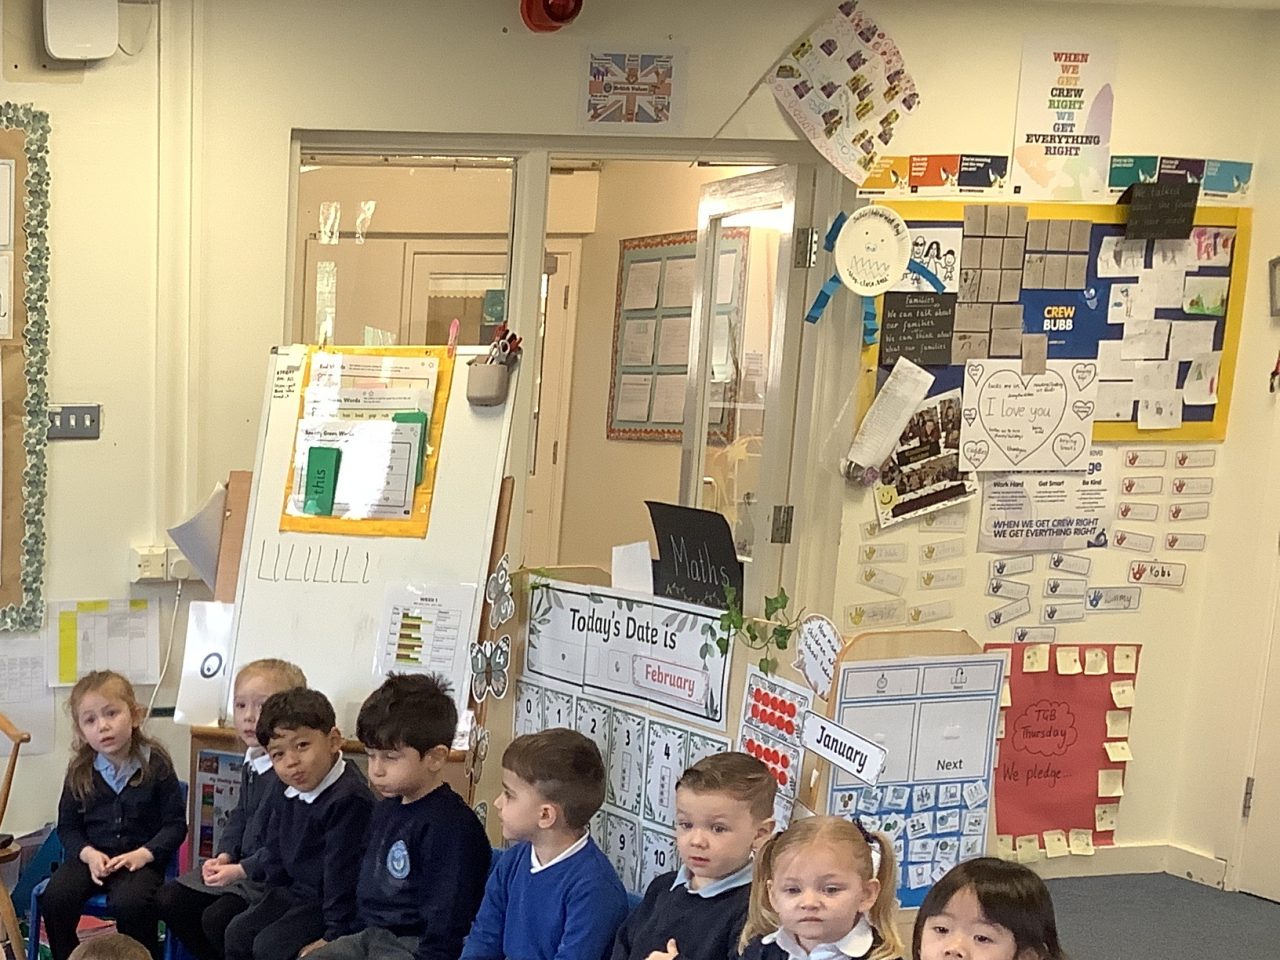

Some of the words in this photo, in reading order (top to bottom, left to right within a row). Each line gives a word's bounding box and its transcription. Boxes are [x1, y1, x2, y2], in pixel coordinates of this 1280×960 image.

[1053, 52, 1089, 63] WHEN
[1061, 64, 1079, 74] WE
[1057, 76, 1080, 86] GET
[1050, 88, 1084, 98] CREW
[1048, 100, 1084, 110] RIGHT
[1056, 111, 1075, 121] WE
[1053, 123, 1075, 133] GET
[1025, 134, 1101, 146] EVERYTHING
[1044, 146, 1080, 156] RIGHT
[1044, 306, 1076, 318] CREW
[1043, 319, 1073, 331] BUBB
[985, 397, 997, 417] I
[1001, 399, 1026, 418] love
[1029, 407, 1051, 423] you
[312, 469, 326, 495] this
[993, 520, 1020, 529] WHEN
[1021, 520, 1034, 529] WE
[1035, 520, 1051, 528] GET
[1051, 518, 1075, 527] CREW
[1075, 518, 1099, 526] RIGHT
[993, 530, 1007, 538] WE
[1008, 529, 1025, 538] GET
[1025, 528, 1072, 537] EVERYTHING
[1073, 526, 1098, 536] RIGHT
[670, 534, 730, 586] Maths
[570, 608, 621, 642] Today's
[626, 616, 659, 646] Date
[663, 626, 677, 650] is
[644, 663, 696, 698] February
[526, 699, 532, 713] 0
[556, 709, 562, 723] 1
[590, 719, 597, 734] 2
[625, 730, 631, 746] 3
[1021, 725, 1068, 749] Thursday
[663, 744, 671, 760] 4
[816, 725, 869, 774] January
[936, 759, 964, 771] Next
[1002, 763, 1019, 782] We
[619, 835, 626, 850] 9
[653, 849, 666, 867] 10
